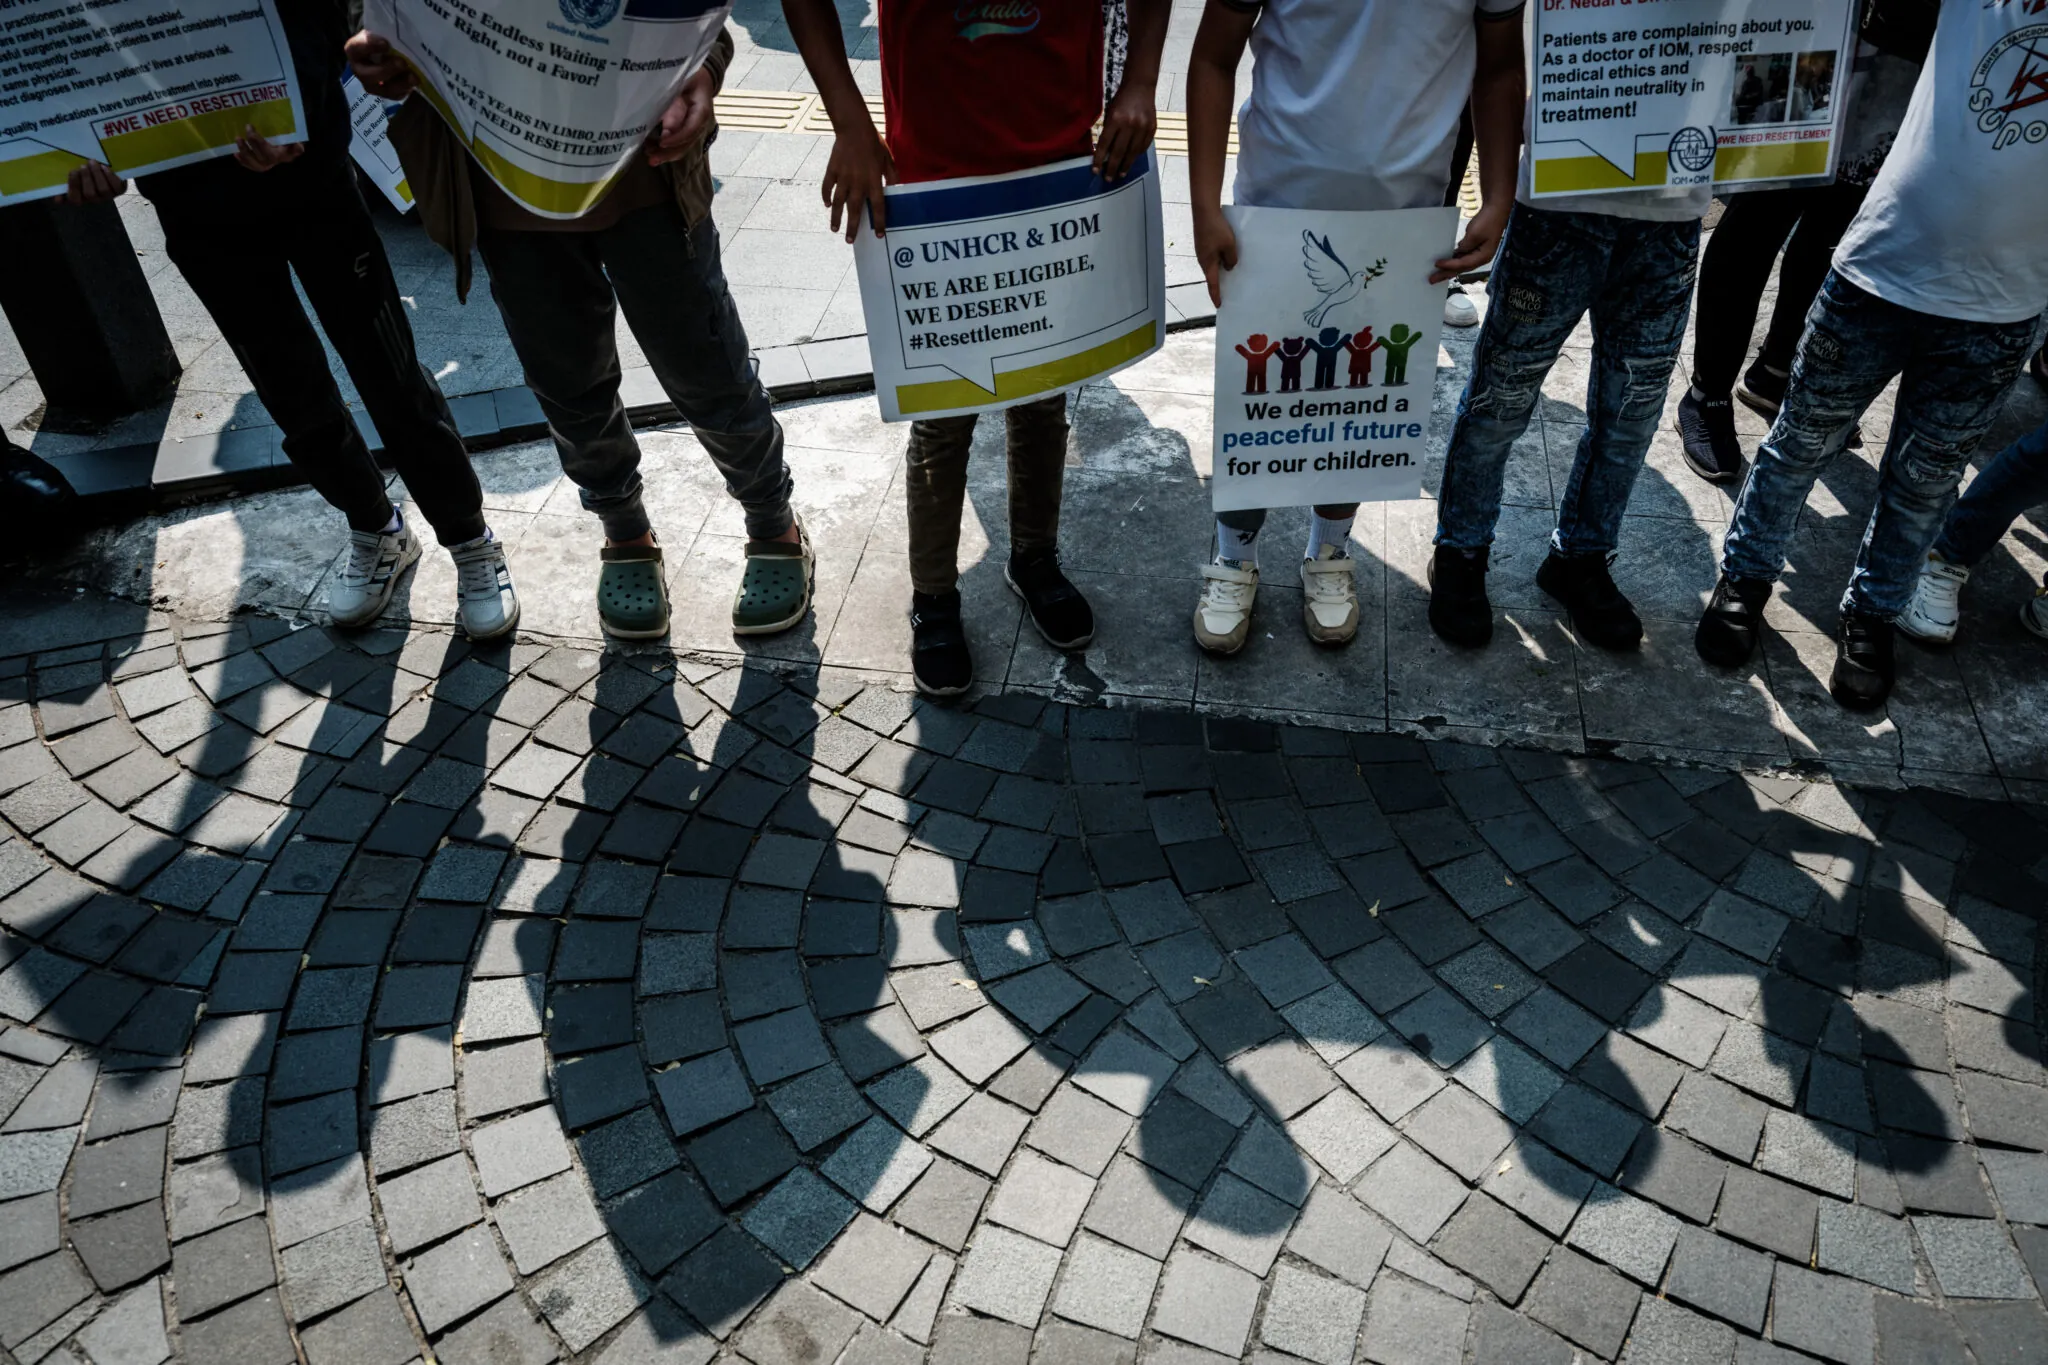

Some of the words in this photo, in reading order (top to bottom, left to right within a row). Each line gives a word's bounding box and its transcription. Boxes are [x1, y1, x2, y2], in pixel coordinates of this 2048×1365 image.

[66, 3, 84, 15] and
[2, 66, 18, 77] are
[19, 53, 69, 73] frequently
[115, 33, 151, 51] patients
[151, 30, 166, 41] are
[166, 25, 181, 37] not
[181, 15, 227, 34] consistently
[16, 28, 45, 43] rarely
[22, 39, 69, 56] surgeries
[67, 32, 92, 46] have
[91, 27, 109, 39] left
[110, 19, 146, 37] patients
[443, 0, 477, 19] ore
[479, 11, 545, 52] Endless
[549, 41, 608, 72] Waiting
[1543, 31, 1607, 48] Patients
[1612, 30, 1637, 43] are
[1642, 21, 1737, 41] complaining
[1741, 18, 1782, 34] about
[1785, 19, 1815, 35] you.
[453, 15, 502, 55] Right,
[505, 48, 535, 69] not
[536, 61, 547, 74] a
[549, 62, 600, 87] Favor!
[1542, 52, 1563, 66] As
[1568, 54, 1577, 64] a
[1582, 48, 1634, 63] doctor
[1639, 44, 1655, 59] of
[1659, 42, 1693, 58] IOM,
[1698, 39, 1753, 56] respect
[2, 79, 29, 92] same
[31, 66, 81, 88] physician.
[20, 82, 71, 103] diagnoses
[70, 76, 95, 91] have
[96, 71, 113, 87] put
[151, 57, 174, 70] lives
[174, 55, 185, 65] at
[183, 48, 216, 62] serious
[1542, 66, 1604, 84] medical
[1608, 63, 1656, 79] ethics
[1661, 60, 1690, 76] and
[39, 106, 99, 128] medications
[98, 98, 123, 114] have
[122, 88, 155, 106] turned
[154, 78, 196, 99] treatment
[195, 75, 214, 88] into
[454, 72, 487, 100] 13-15
[487, 95, 532, 126] YEARS
[532, 118, 551, 133] IN
[1542, 84, 1609, 103] maintain
[1614, 80, 1687, 97] neutrality
[1691, 78, 1705, 92] in
[103, 115, 142, 138] #WE
[144, 103, 189, 127] NEED
[190, 82, 289, 116] RESETTLEMENT
[353, 103, 378, 128] Indonesia
[1542, 101, 1637, 123] treatment!
[480, 105, 521, 136] NEED
[523, 130, 626, 157] RESETTLEMENT
[1716, 135, 1736, 144] #WE
[1738, 133, 1762, 143] NEED
[1765, 129, 1832, 140] RESETTLEMENT
[1672, 176, 1688, 185] IOM
[1694, 175, 1710, 184] OIM
[894, 247, 914, 268] @
[920, 230, 1018, 263] UNHCR
[1026, 227, 1044, 248] &
[1050, 213, 1101, 241] IOM
[901, 281, 938, 300] WE
[943, 275, 989, 297] ARE
[995, 254, 1095, 290] ELIGIBLE,
[905, 306, 942, 326] WE
[946, 290, 1047, 322] DESERVE
[909, 316, 1054, 350] #Resettlement.
[1245, 401, 1282, 421] We
[1289, 394, 1388, 418] demand
[1395, 397, 1409, 412] a
[1222, 421, 1335, 452] peaceful
[1342, 420, 1422, 441] future
[1227, 457, 1261, 476] for
[1267, 457, 1307, 474] our
[1313, 449, 1416, 471] children.
